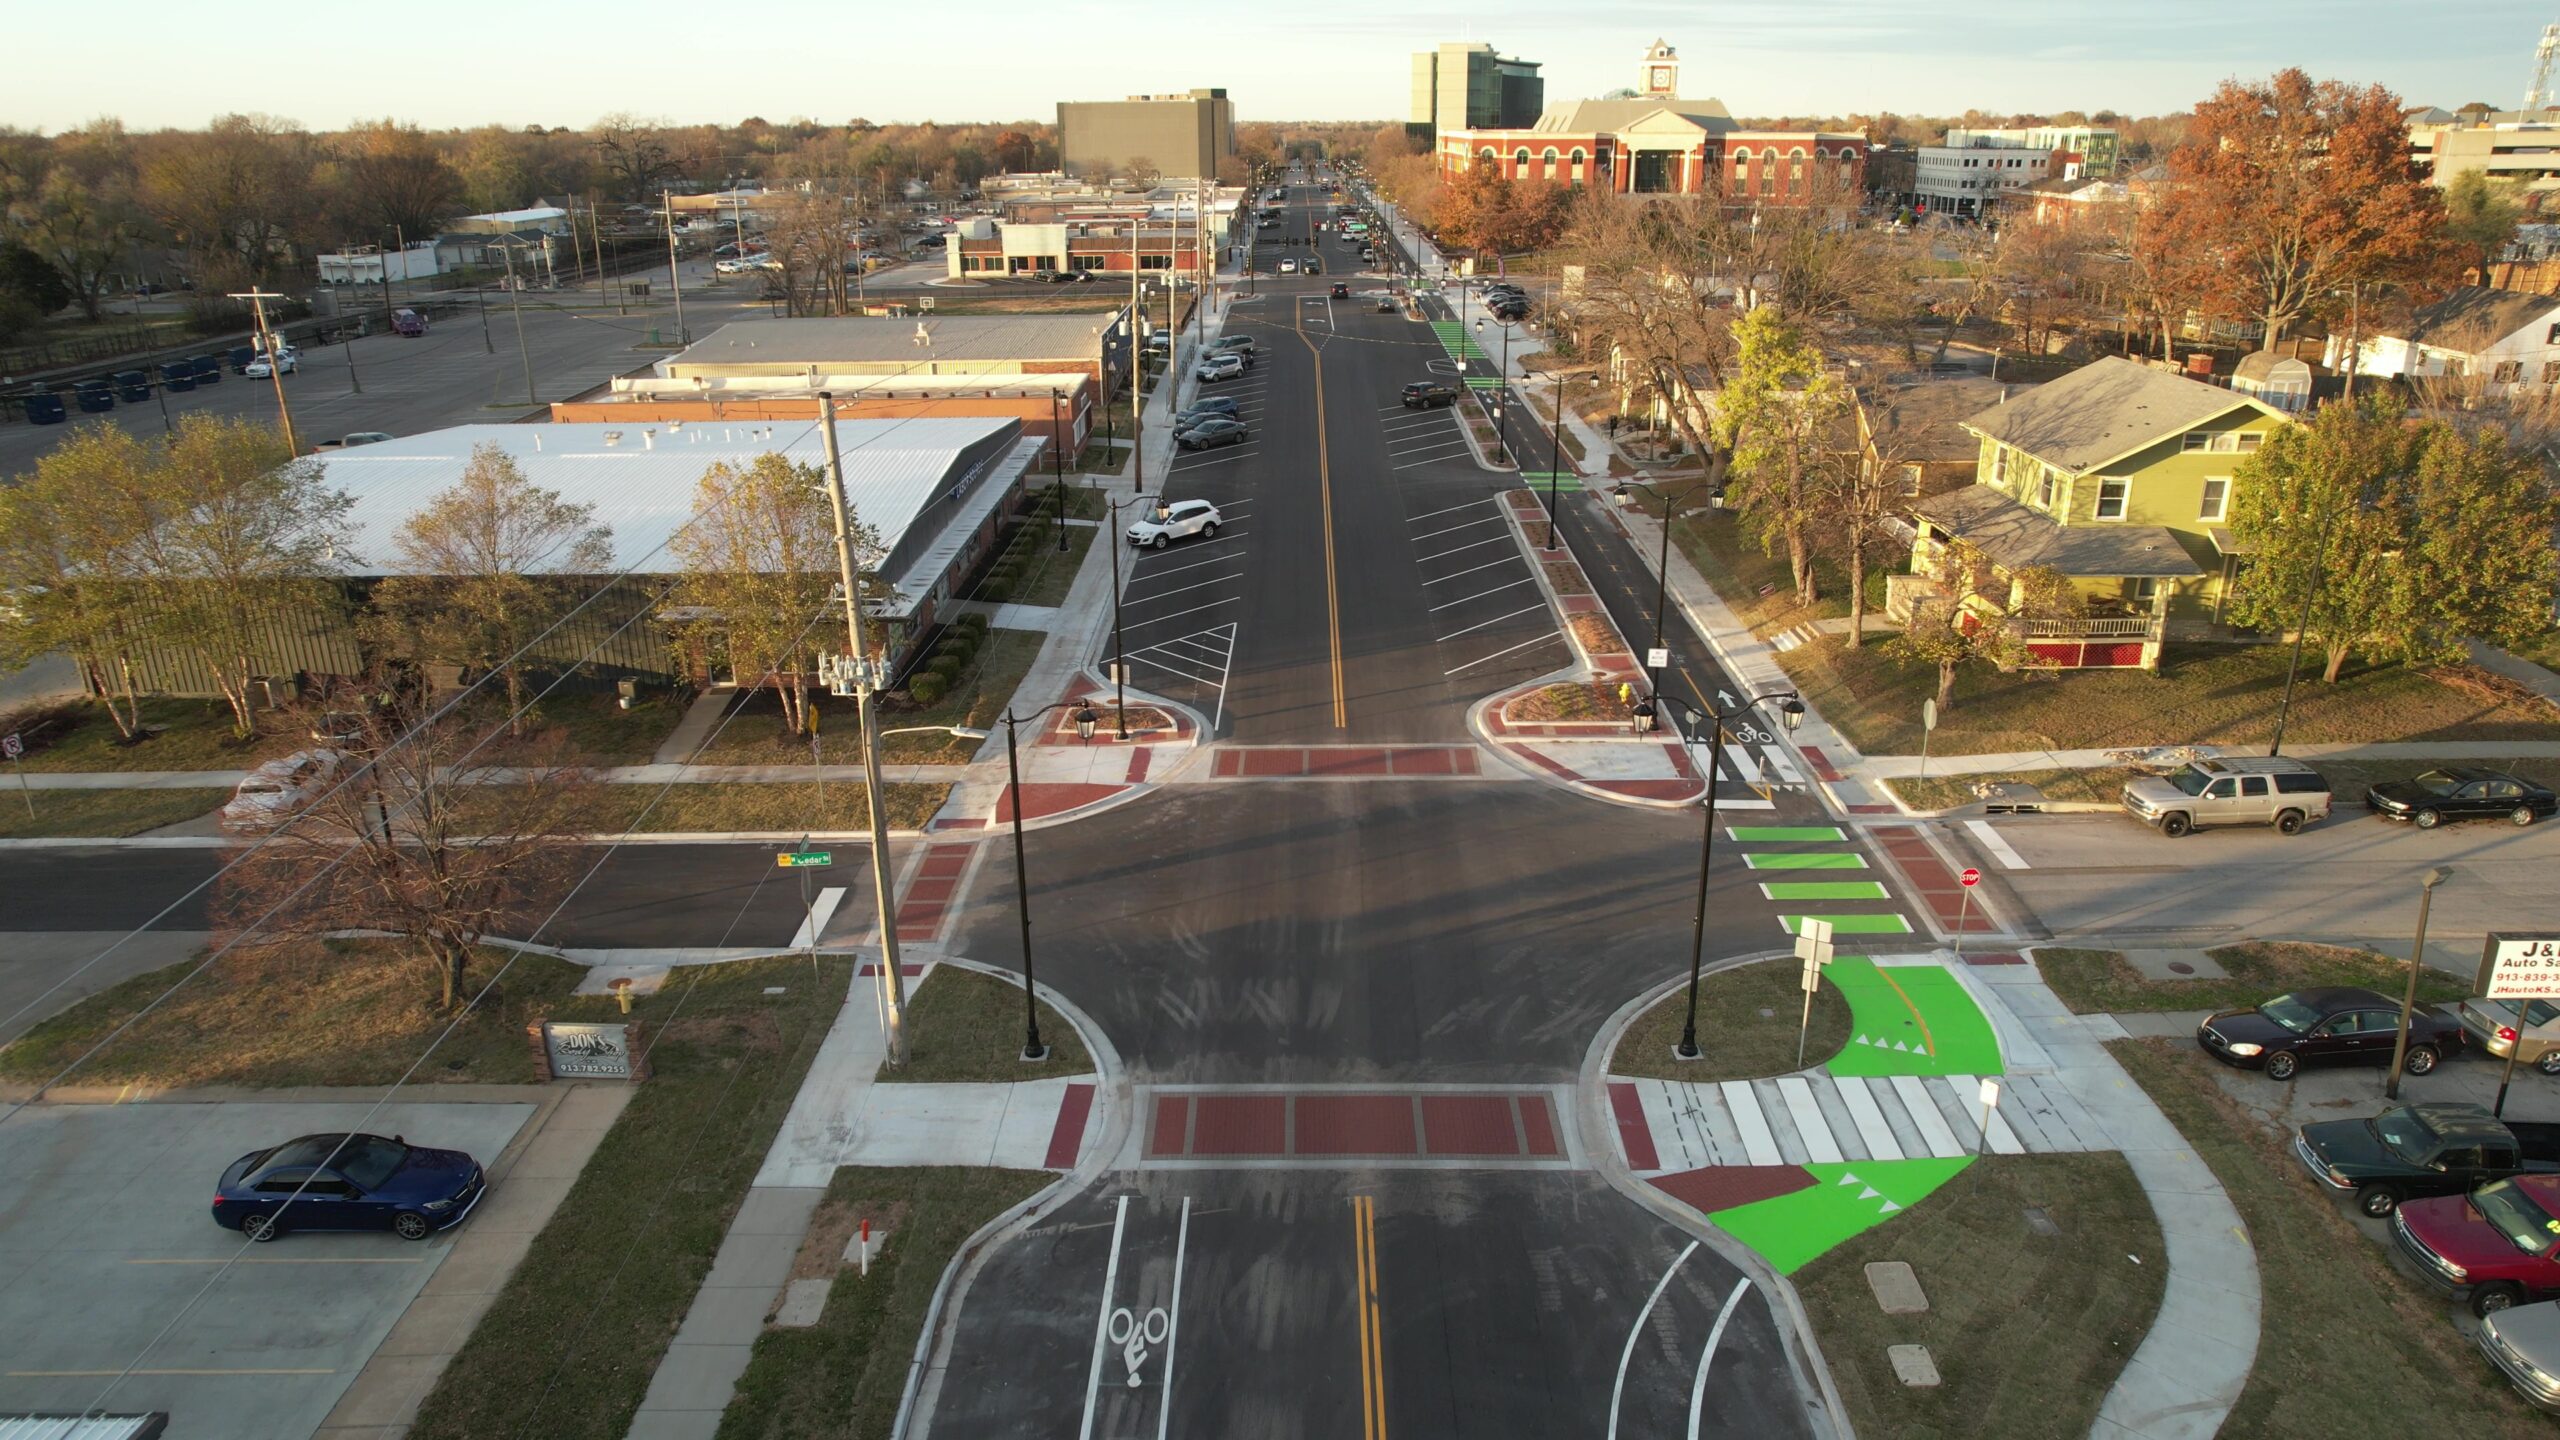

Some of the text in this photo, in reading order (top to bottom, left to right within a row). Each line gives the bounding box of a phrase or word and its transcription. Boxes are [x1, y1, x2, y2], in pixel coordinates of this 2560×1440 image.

[2522, 942, 2560, 957] J&
[2502, 958, 2538, 967] Auto
[570, 1033, 606, 1048] DON'S
[560, 1064, 625, 1073] 913.782.9255
